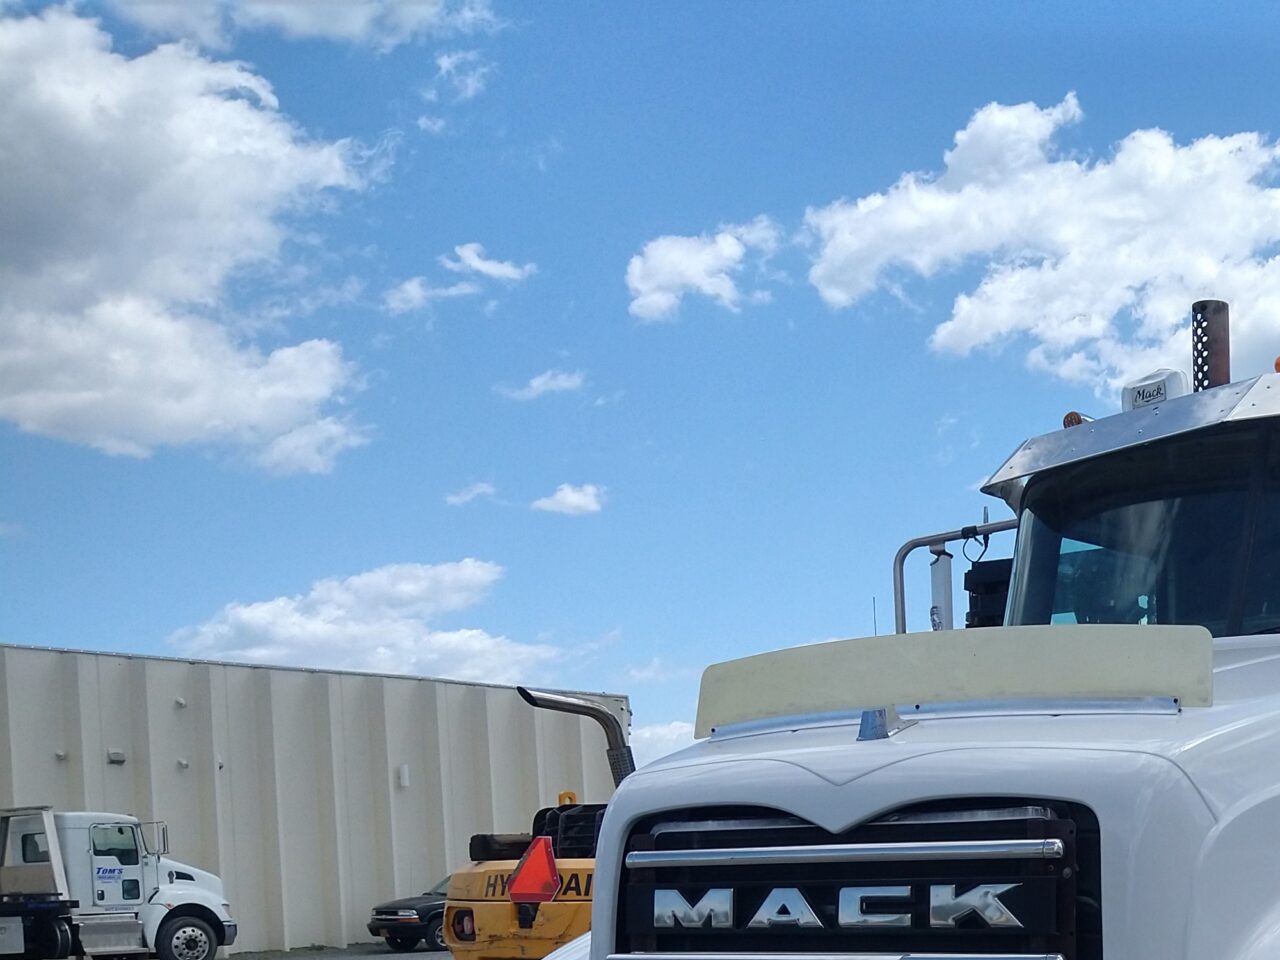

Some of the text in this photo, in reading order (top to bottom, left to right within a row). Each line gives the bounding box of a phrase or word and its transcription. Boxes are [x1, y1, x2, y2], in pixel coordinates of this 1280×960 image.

[1135, 384, 1164, 403] Mack
[484, 873, 593, 897] HYAI
[653, 883, 1025, 928] MACK
